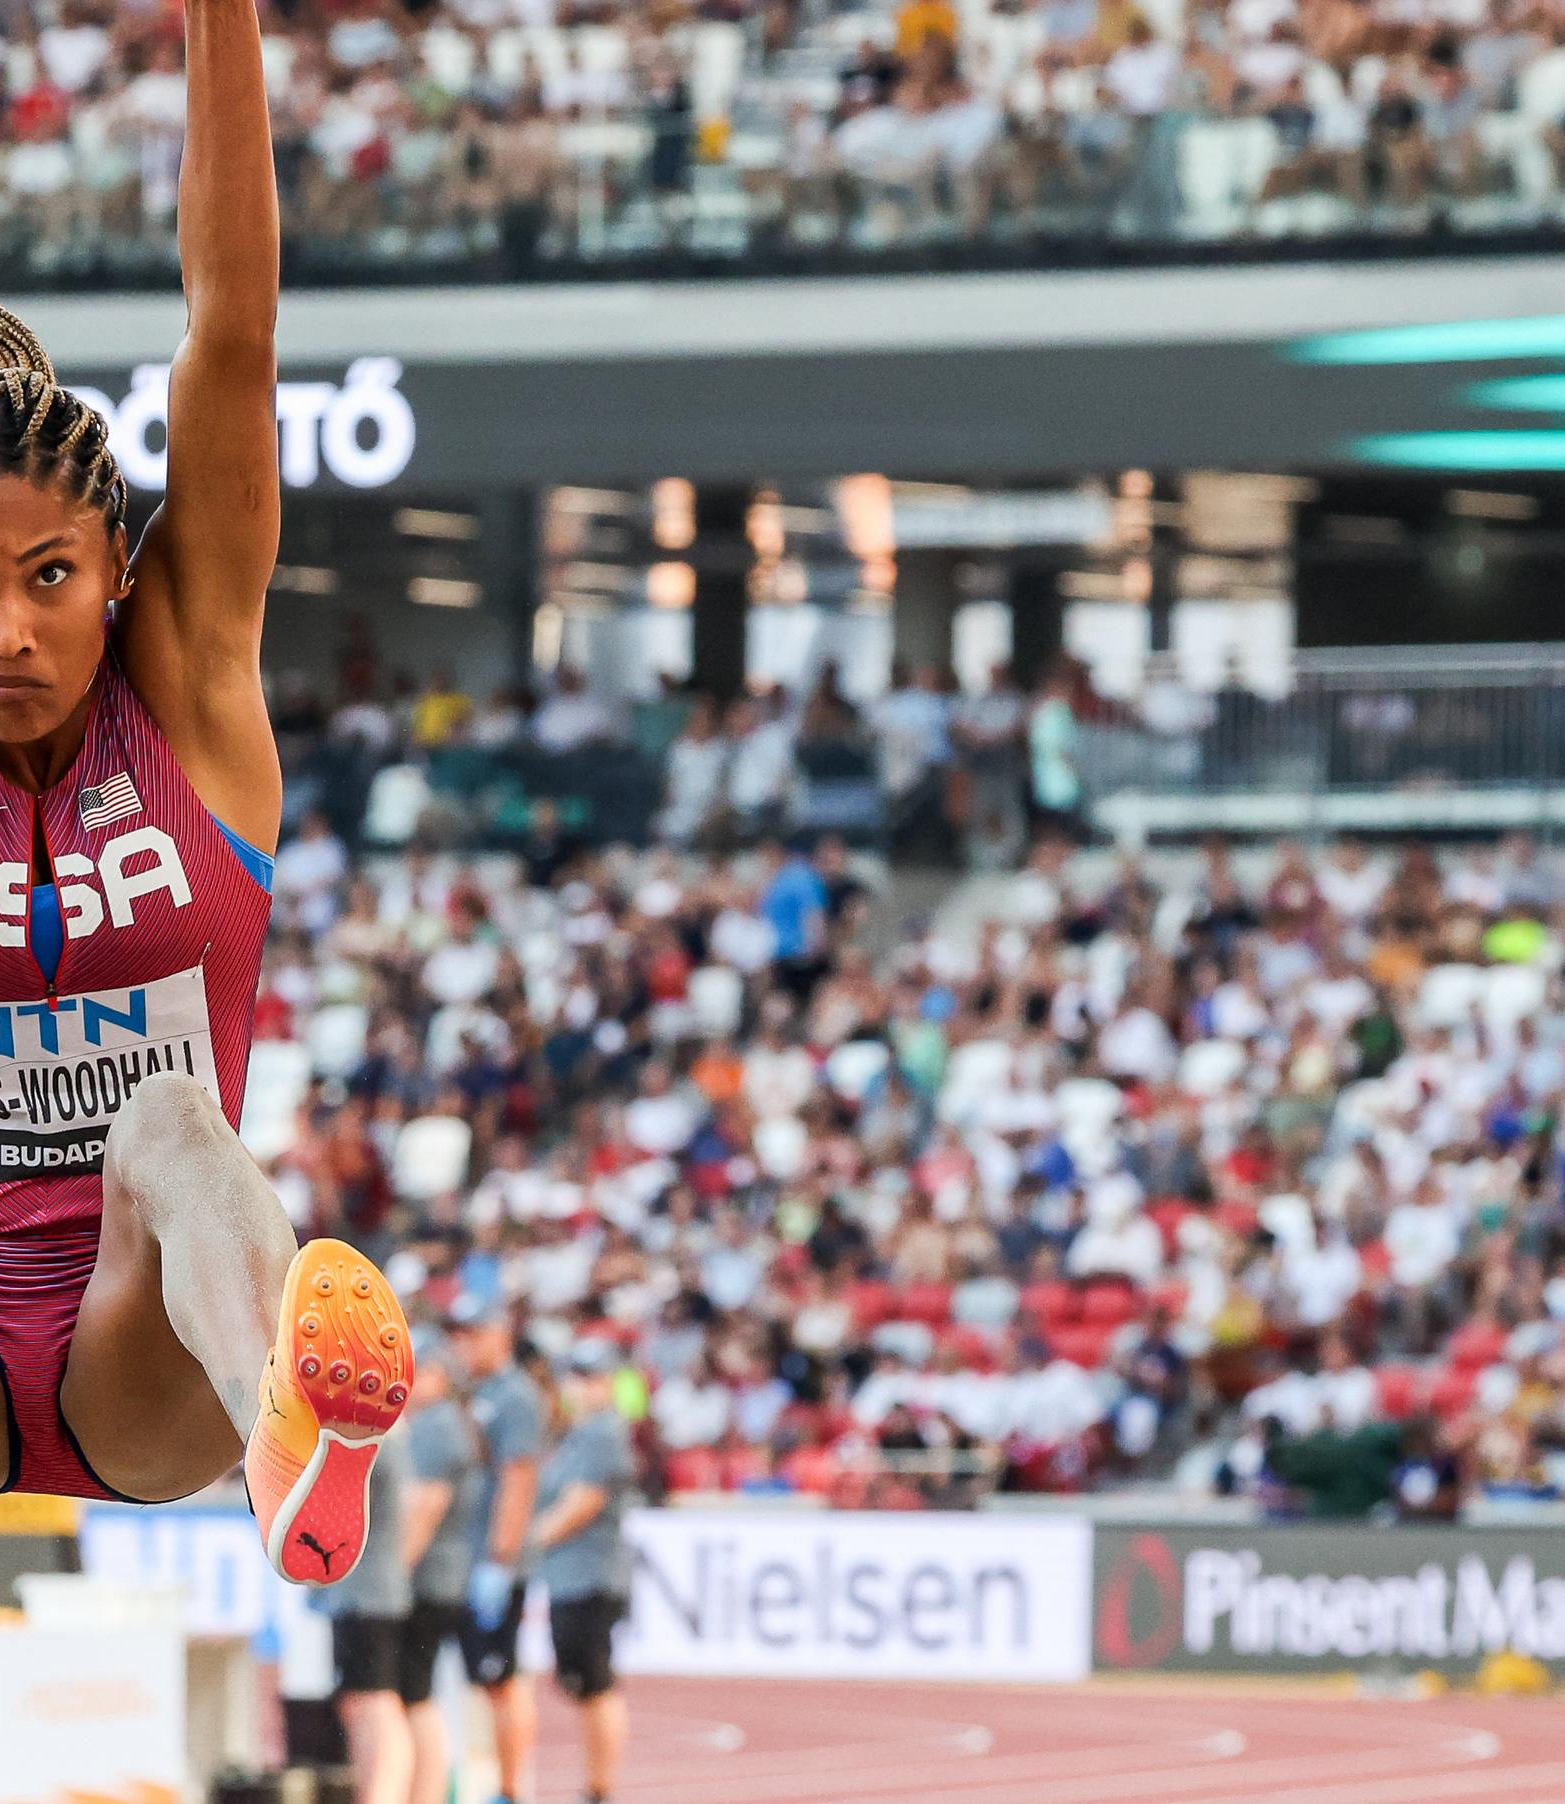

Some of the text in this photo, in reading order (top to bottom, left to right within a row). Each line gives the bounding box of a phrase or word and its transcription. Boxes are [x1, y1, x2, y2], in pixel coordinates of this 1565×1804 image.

[0, 1140, 105, 1167] BUDAP
[632, 1537, 1030, 1652] Nielsen
[1182, 1548, 1449, 1658] Pinsent
